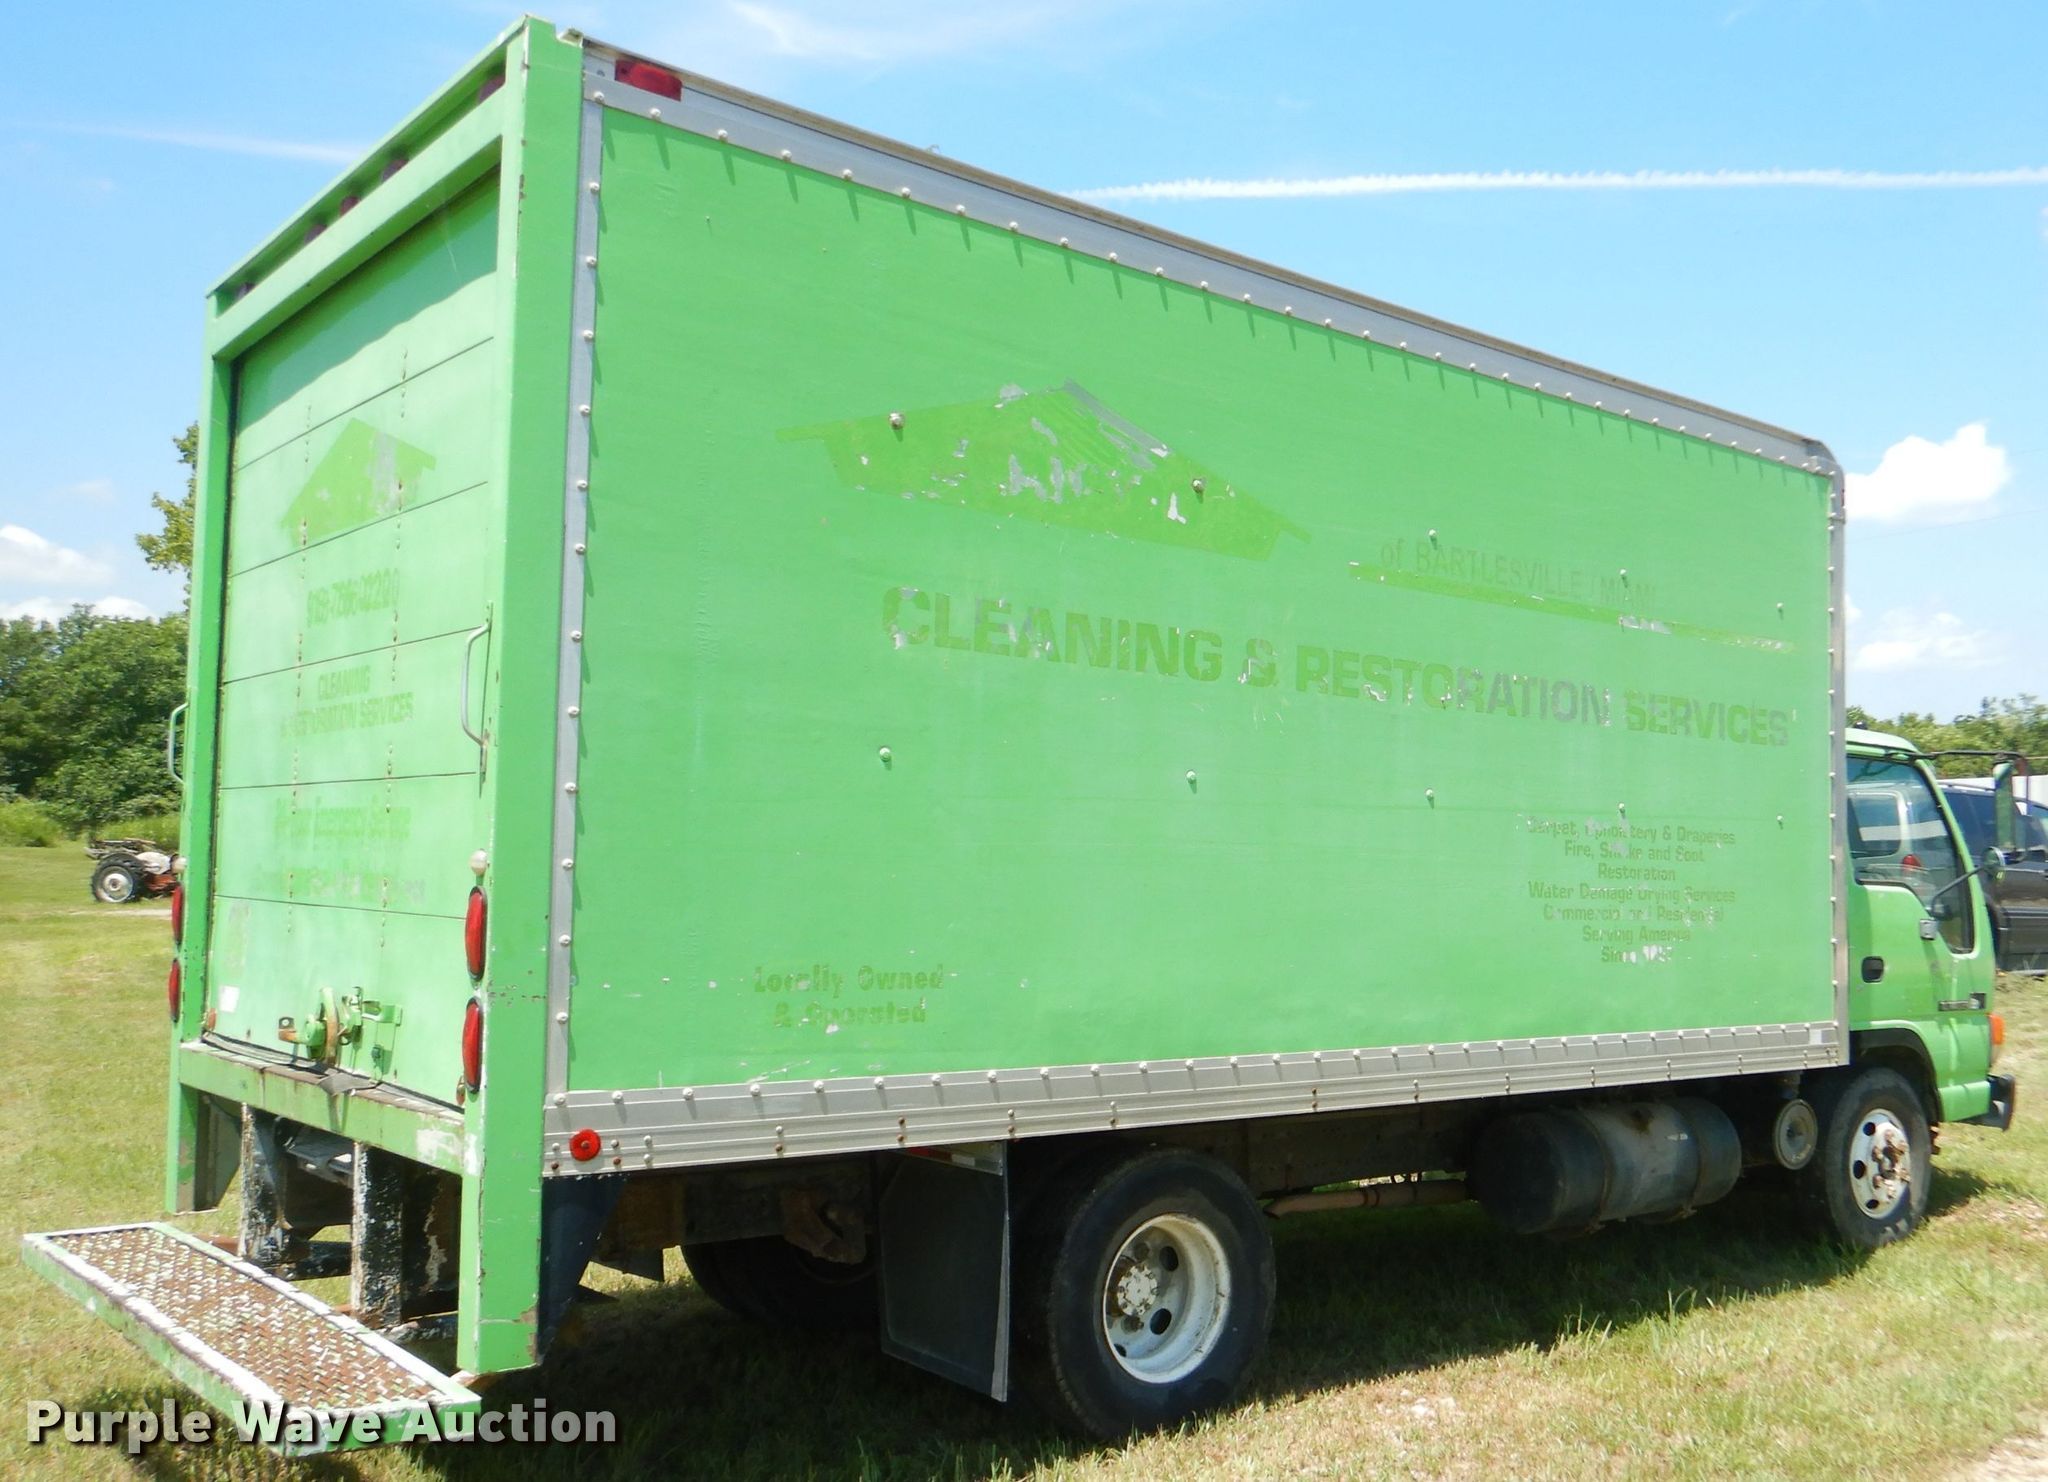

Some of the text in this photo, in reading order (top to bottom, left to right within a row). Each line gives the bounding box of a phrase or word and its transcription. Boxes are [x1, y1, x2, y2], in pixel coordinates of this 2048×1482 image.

[1416, 542, 1583, 601] BARTLESVILLE
[882, 585, 1223, 682] CLEANING
[1296, 644, 1610, 726] RESTORATION
[1623, 688, 1791, 747] SERVICES
[1662, 825, 1672, 841] &
[1564, 839, 1705, 863] Fire, Smke and Soot
[1598, 862, 1676, 882] Restoration
[1528, 880, 1574, 899] Water
[1580, 882, 1633, 902] Damage
[1544, 903, 1622, 922] Cmmercia
[857, 962, 945, 992] Owned
